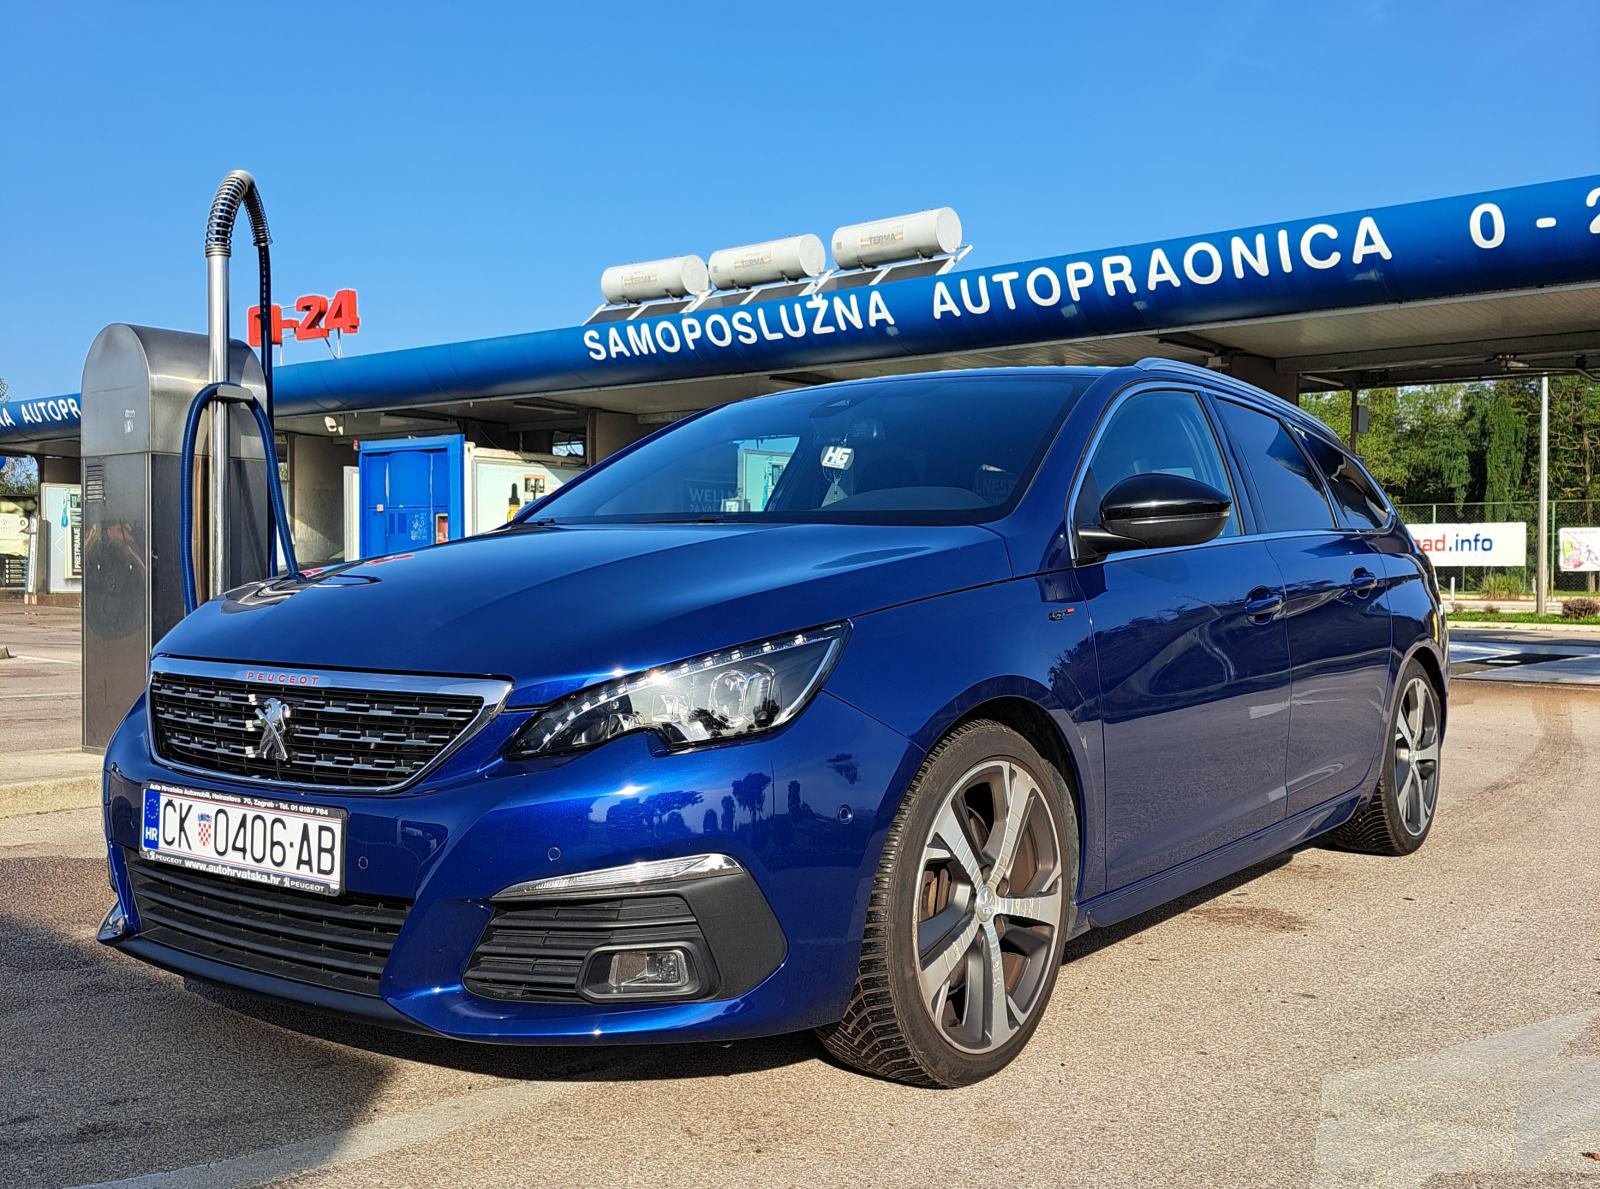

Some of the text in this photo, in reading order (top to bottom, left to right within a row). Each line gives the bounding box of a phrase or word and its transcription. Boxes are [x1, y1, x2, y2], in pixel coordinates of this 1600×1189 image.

[583, 290, 895, 361] SAMOPOSLUŽNA
[932, 215, 1393, 320] AUTOPRAONICA
[1469, 202, 1506, 249] 0
[247, 288, 360, 348] 0-24
[247, 671, 319, 685] PEUGEOT
[149, 783, 161, 791] Auto
[253, 799, 275, 809] Zagreb
[145, 826, 158, 841] HR
[155, 854, 325, 892] PEUGEOT www.autohrvatska.hr PEUGEOT
